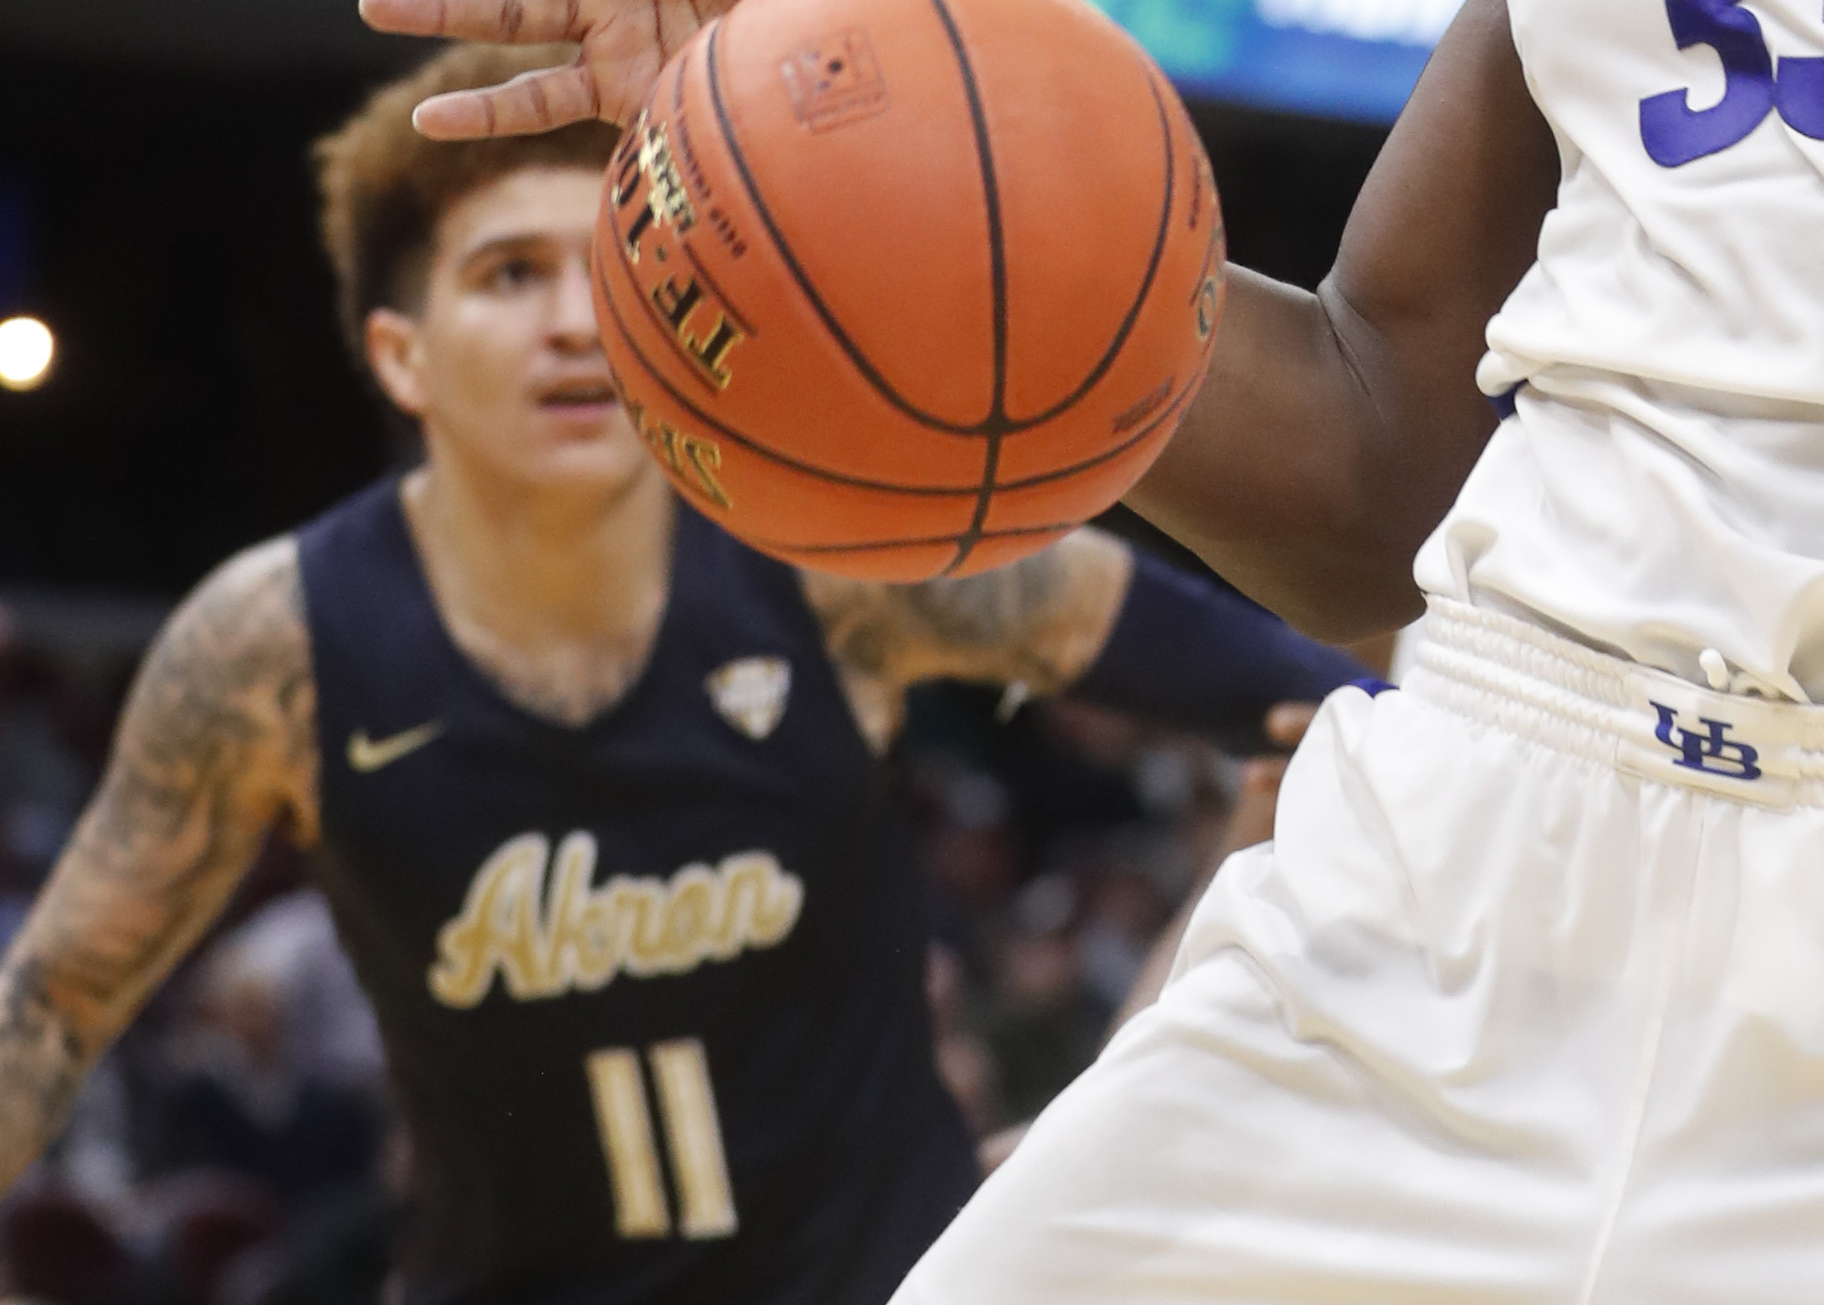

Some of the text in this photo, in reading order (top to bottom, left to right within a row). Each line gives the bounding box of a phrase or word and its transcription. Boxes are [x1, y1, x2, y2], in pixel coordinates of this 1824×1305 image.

[1648, 699, 1763, 781] UB
[427, 828, 806, 1011] Akron
[584, 1036, 740, 1242] 11
